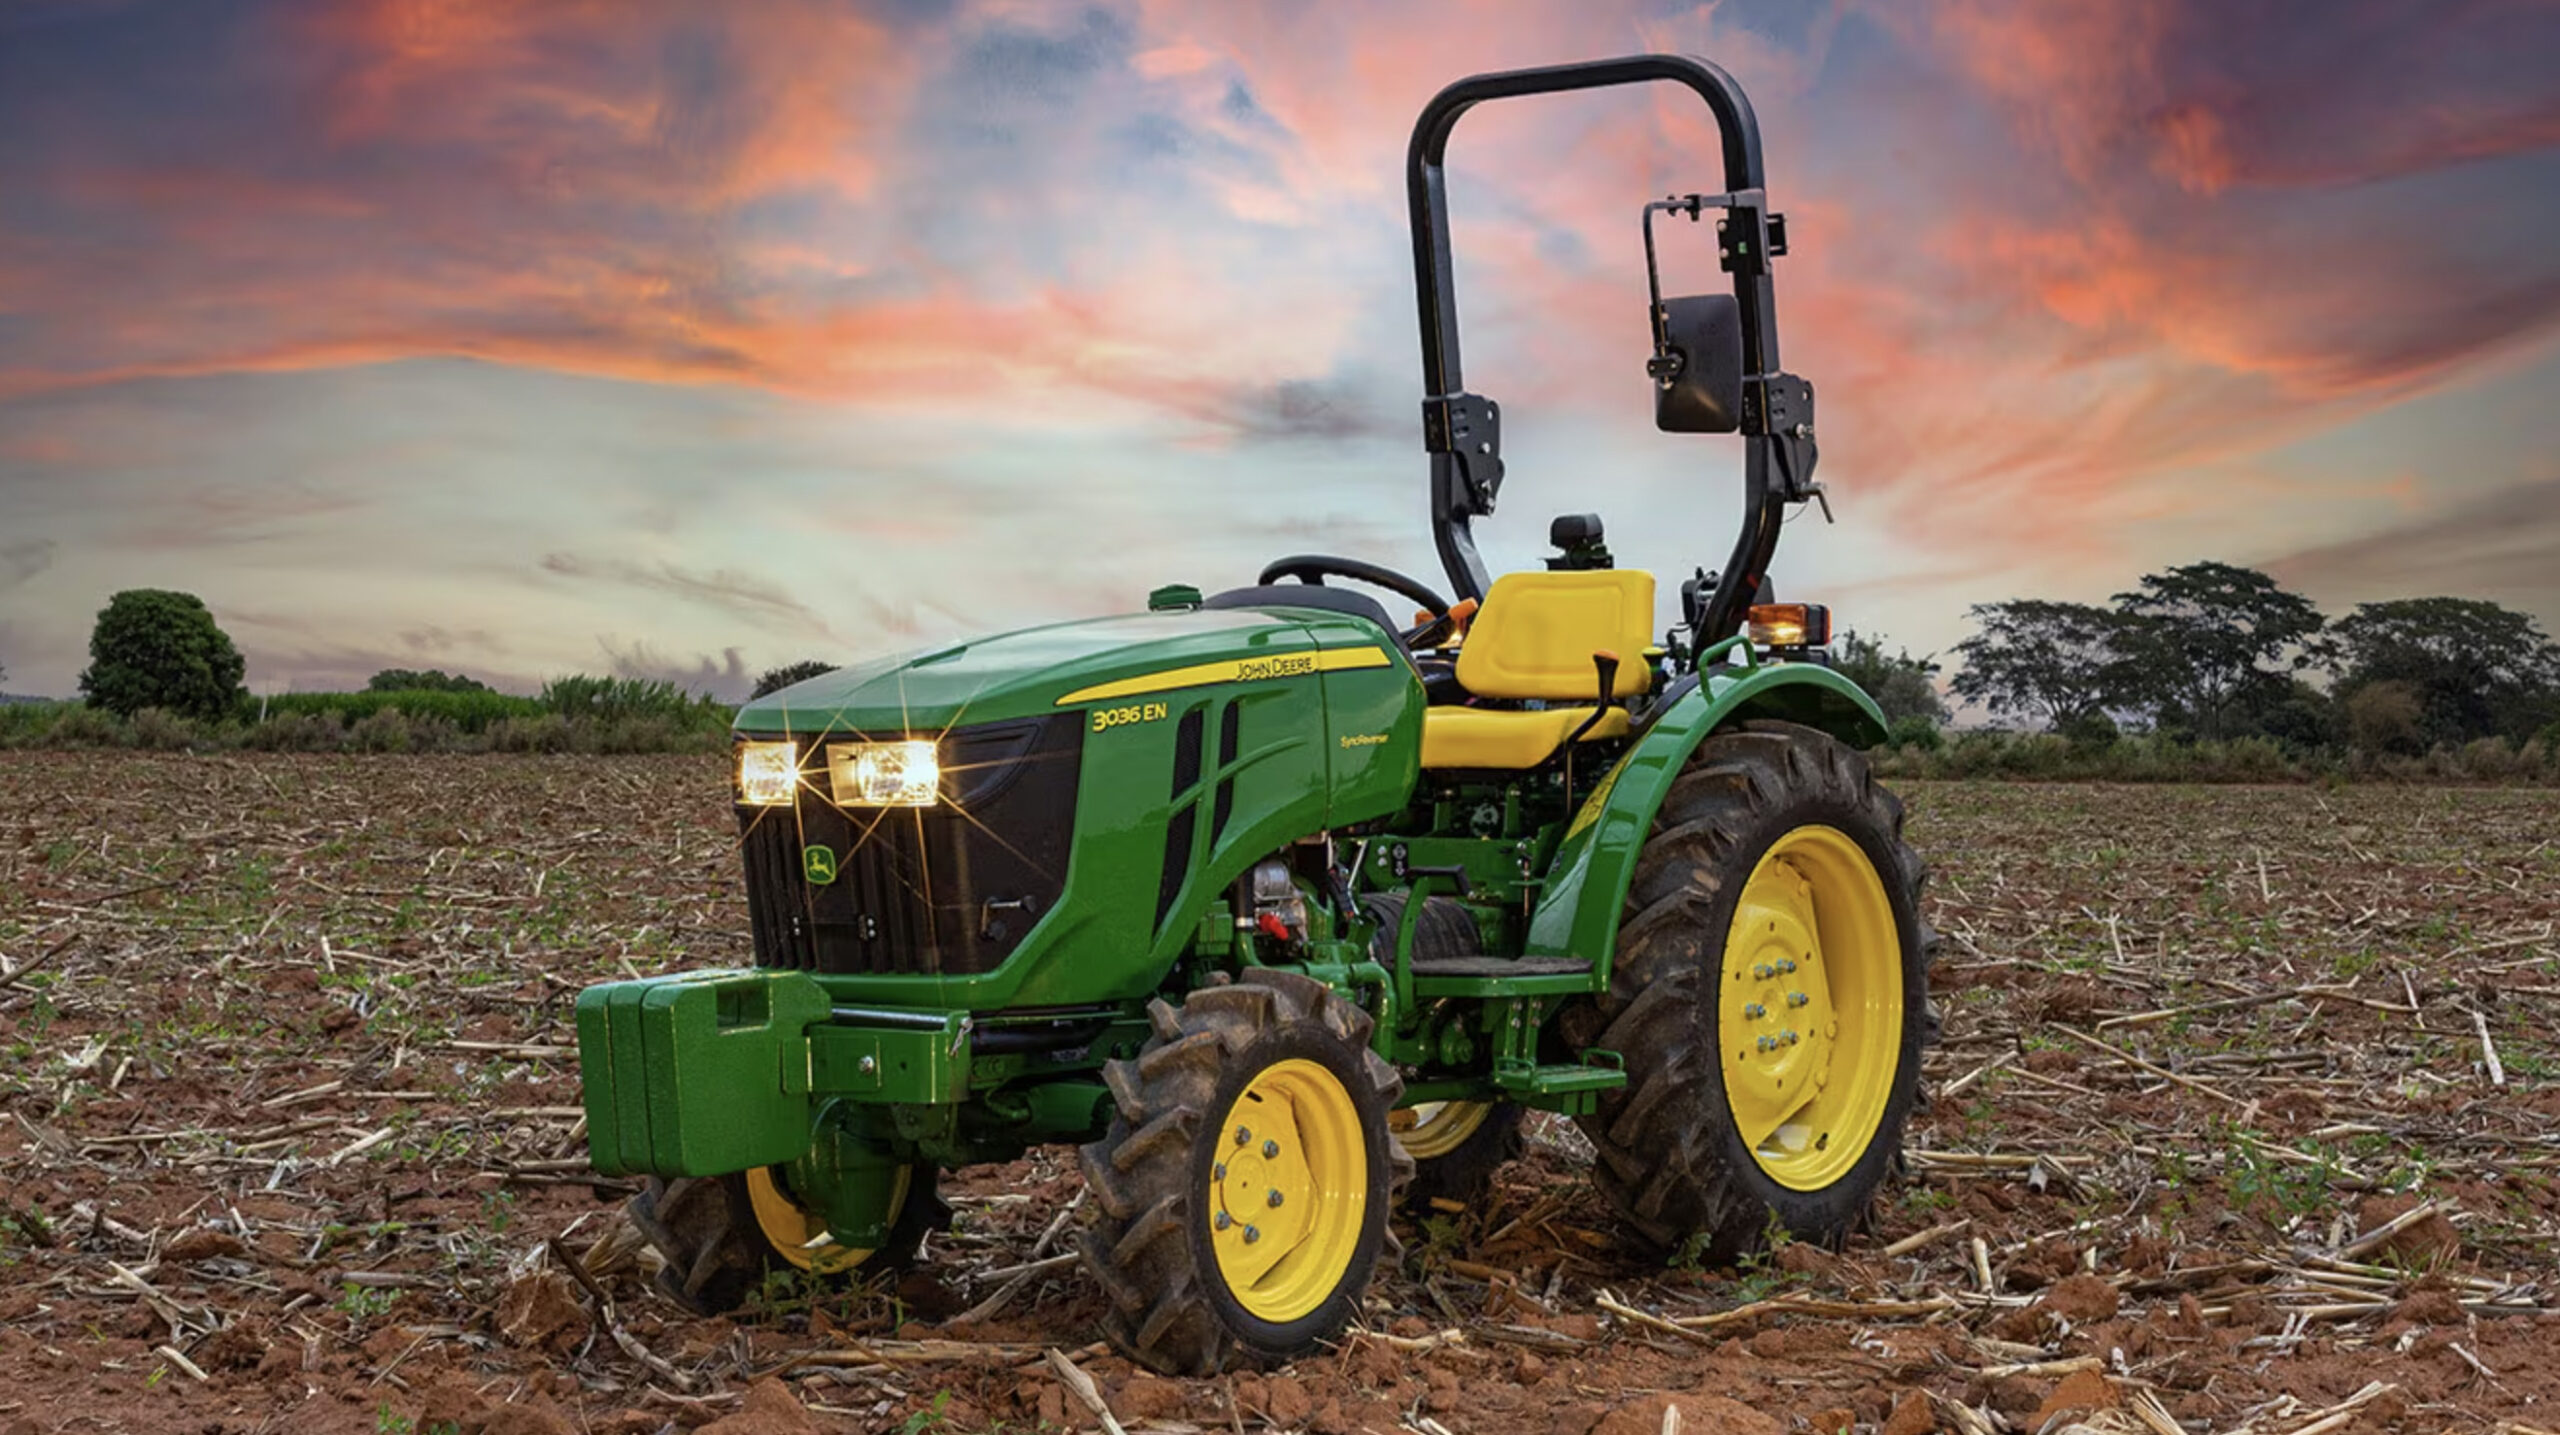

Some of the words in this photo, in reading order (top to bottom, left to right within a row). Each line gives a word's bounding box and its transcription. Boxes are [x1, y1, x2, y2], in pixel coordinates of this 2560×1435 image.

[1236, 662, 1271, 680] JOHN
[1272, 657, 1312, 675] DEERE
[1092, 706, 1141, 732] 3036
[1143, 702, 1167, 721] EN
